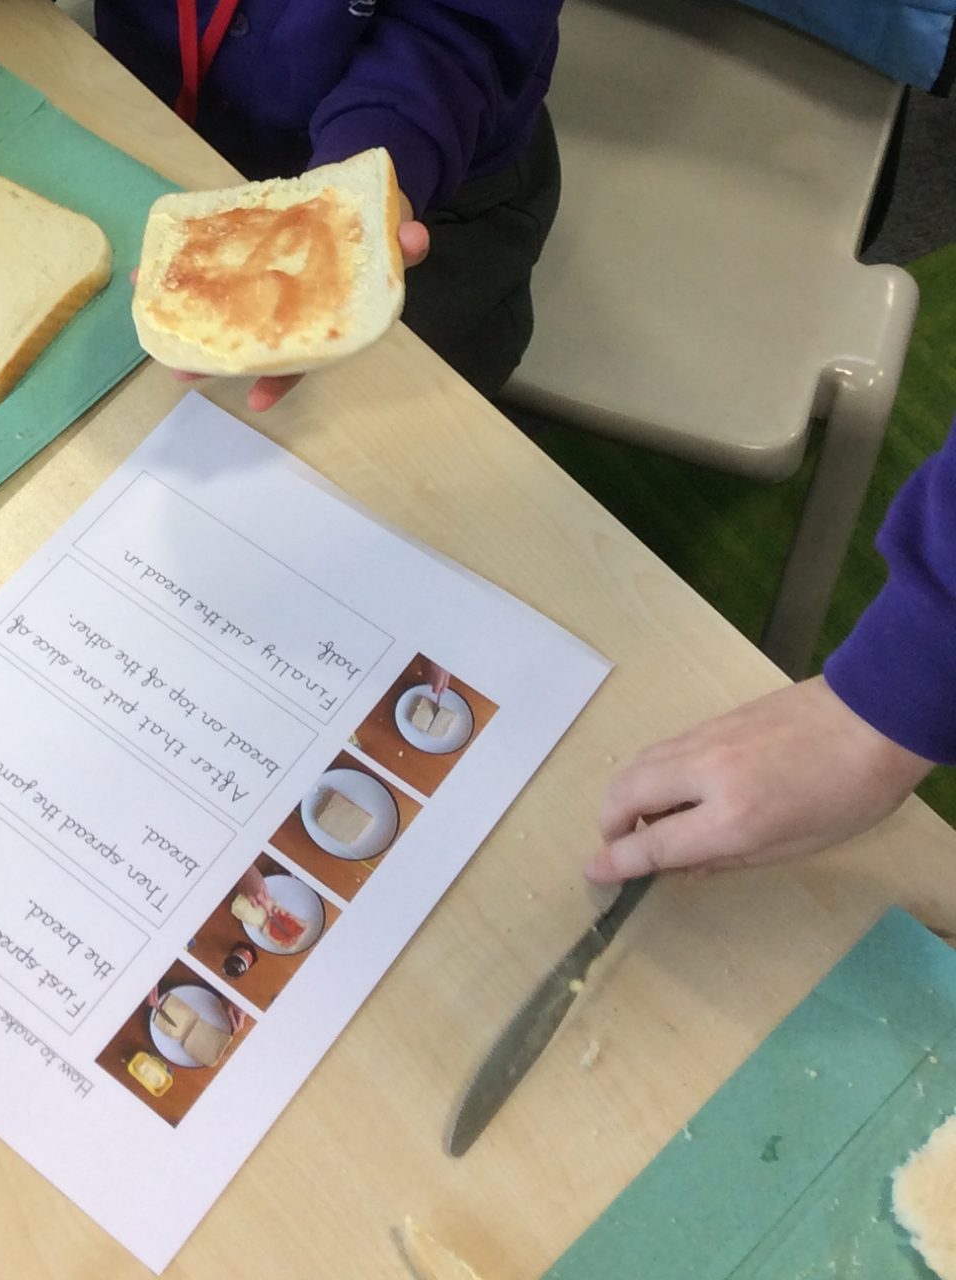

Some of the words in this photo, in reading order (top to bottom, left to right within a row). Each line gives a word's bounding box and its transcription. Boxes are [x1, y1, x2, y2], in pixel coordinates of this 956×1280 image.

[122, 548, 144, 568] in
[138, 563, 193, 608] bread
[4, 613, 33, 636] of
[192, 598, 223, 627] the
[67, 612, 115, 651] other.
[219, 618, 257, 646] cut
[31, 633, 73, 667] slice
[113, 648, 144, 677] the
[315, 639, 362, 681] half.
[71, 663, 106, 691] one
[139, 665, 168, 689] of
[259, 642, 339, 712] Finally
[101, 688, 140, 715] put
[167, 686, 200, 719] top
[136, 714, 188, 758] that
[200, 709, 227, 733] on
[222, 730, 282, 780] bread
[188, 755, 250, 803] After
[31, 790, 63, 822] the
[56, 813, 125, 866] spread
[140, 823, 201, 879] bread.
[125, 862, 169, 914] Then
[23, 897, 84, 956] bread.
[82, 945, 116, 980] the
[36, 967, 87, 1019] First
[38, 1041, 60, 1067] to
[56, 1056, 95, 1099] How
